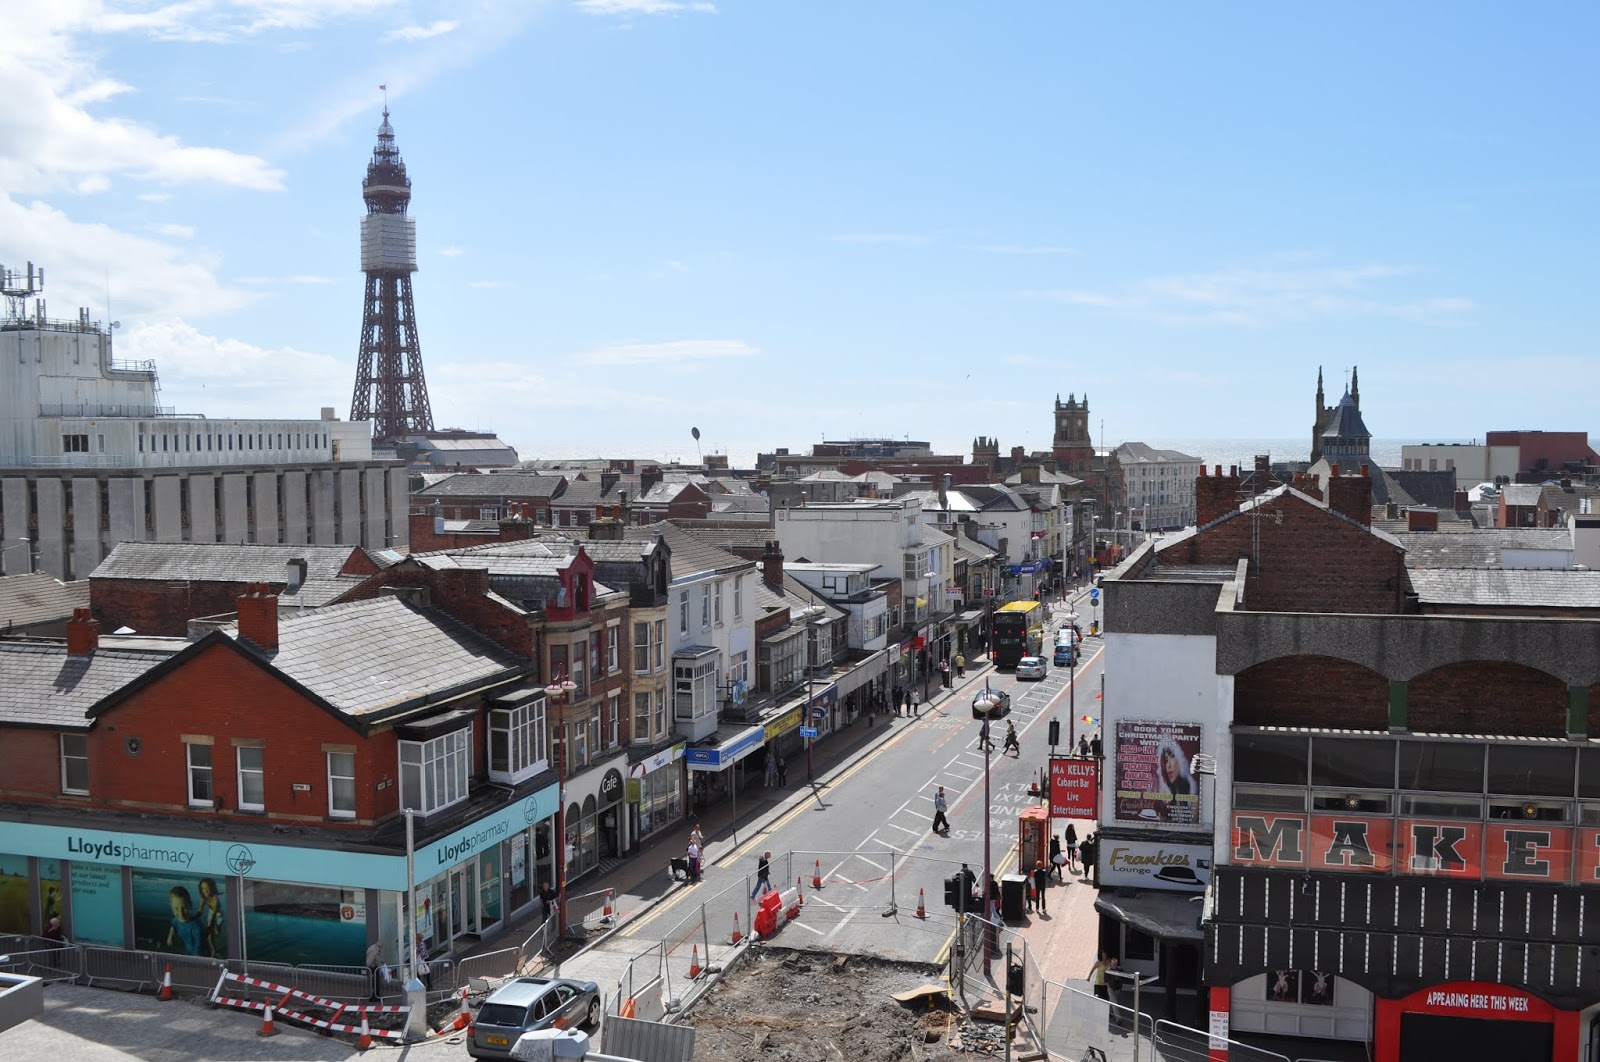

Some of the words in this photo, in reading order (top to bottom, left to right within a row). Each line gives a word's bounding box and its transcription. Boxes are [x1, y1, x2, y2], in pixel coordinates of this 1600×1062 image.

[1118, 732, 1170, 740] CHRISTMAS
[1118, 753, 1159, 763] ENTERTAINMENT
[1123, 763, 1152, 771] PACKAGES
[602, 775, 618, 793] Cafe
[1057, 777, 1079, 787] Cabaret
[1079, 779, 1090, 788] Bar
[994, 793, 1035, 804] TAXI
[1066, 791, 1079, 801] Live
[1053, 805, 1093, 816] Entertainment
[438, 819, 510, 865] Lloydspharmacy
[1234, 815, 1600, 880] MAKE
[68, 837, 194, 868] Lloydspharmacy
[1109, 847, 1190, 866] Frankies
[1112, 865, 1151, 875] Lounge
[1426, 991, 1468, 1008] APPEARING
[1470, 993, 1489, 1010] HERE
[1489, 995, 1506, 1010] THIS
[1507, 996, 1529, 1012] WEEK
